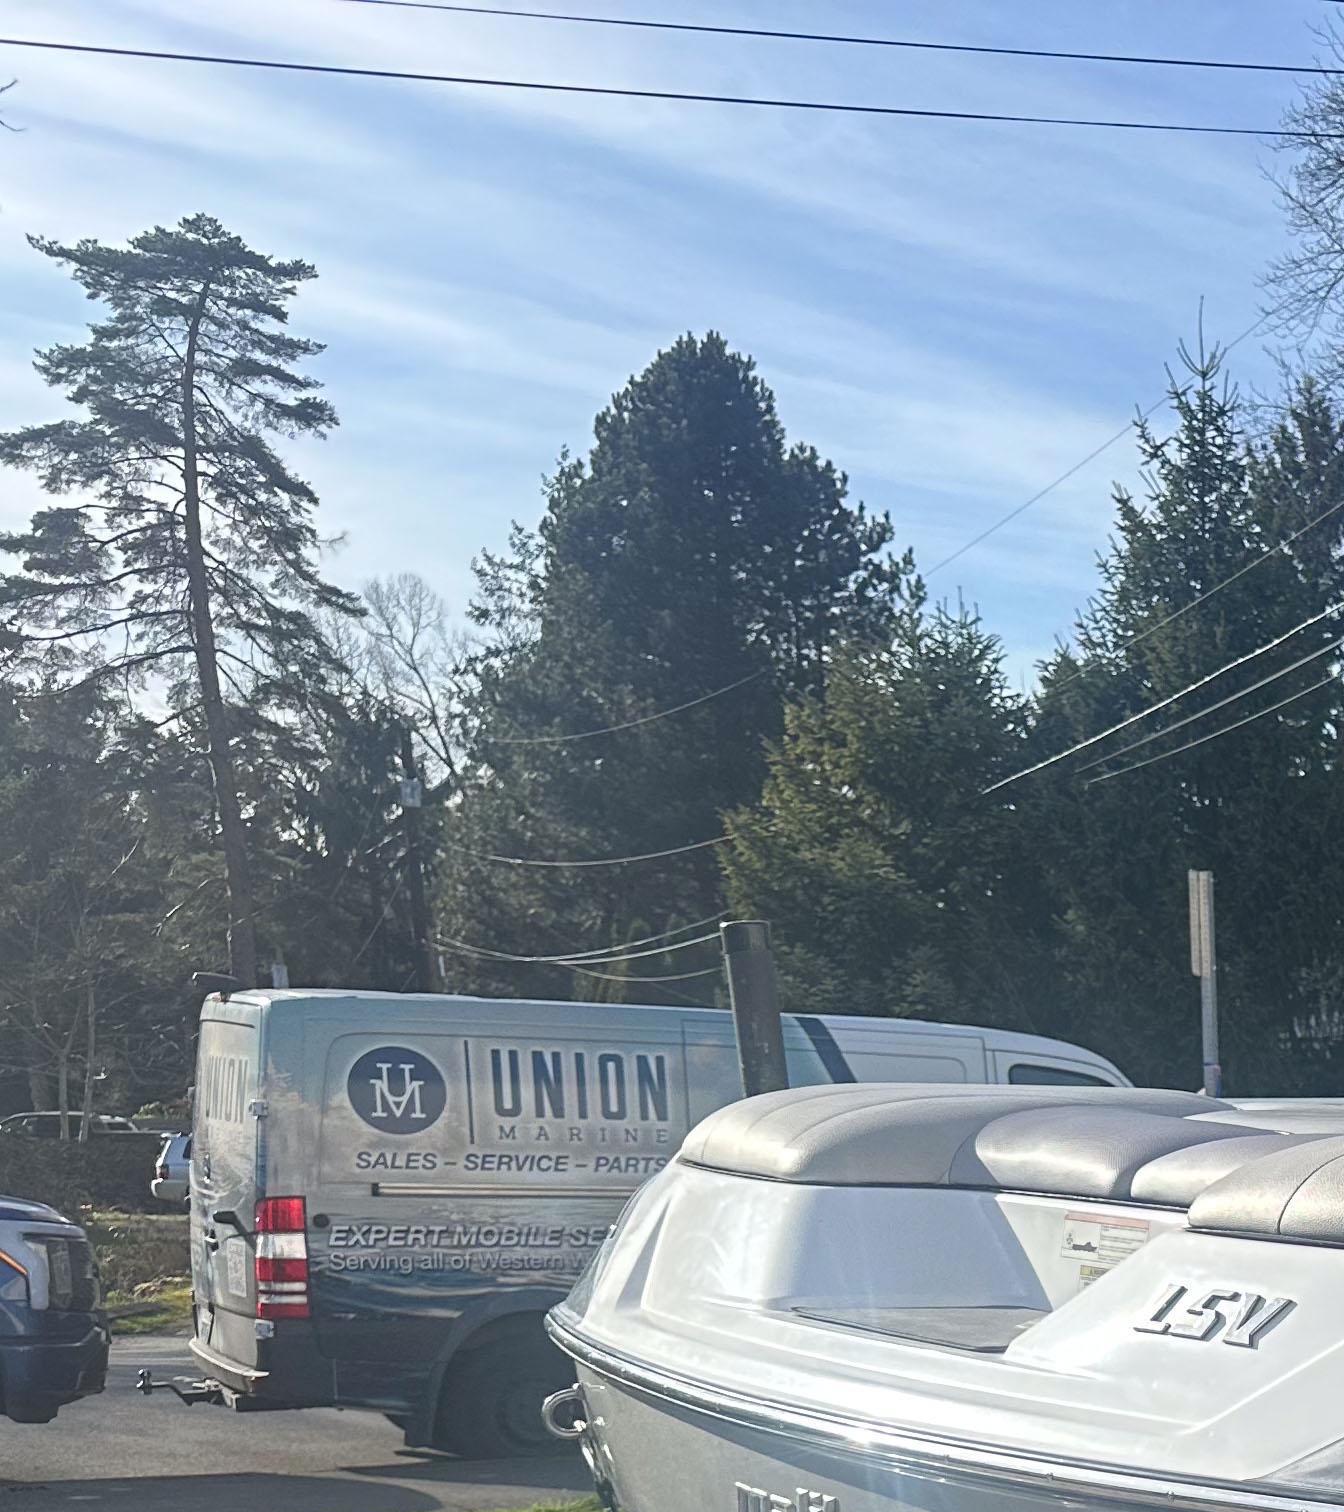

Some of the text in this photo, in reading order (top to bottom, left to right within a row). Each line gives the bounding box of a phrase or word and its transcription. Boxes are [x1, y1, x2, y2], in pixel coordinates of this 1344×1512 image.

[490, 1048, 669, 1121] UNION
[498, 1125, 669, 1144] MARINE
[355, 1151, 668, 1175] SALES SERVICE PARTS
[328, 1225, 446, 1248] EXPERT
[451, 1227, 569, 1249] MOBILE
[329, 1252, 413, 1274] Serving
[419, 1251, 444, 1270] all
[451, 1251, 476, 1270] of
[478, 1253, 565, 1273] Western
[1133, 1284, 1297, 1348] LSV
